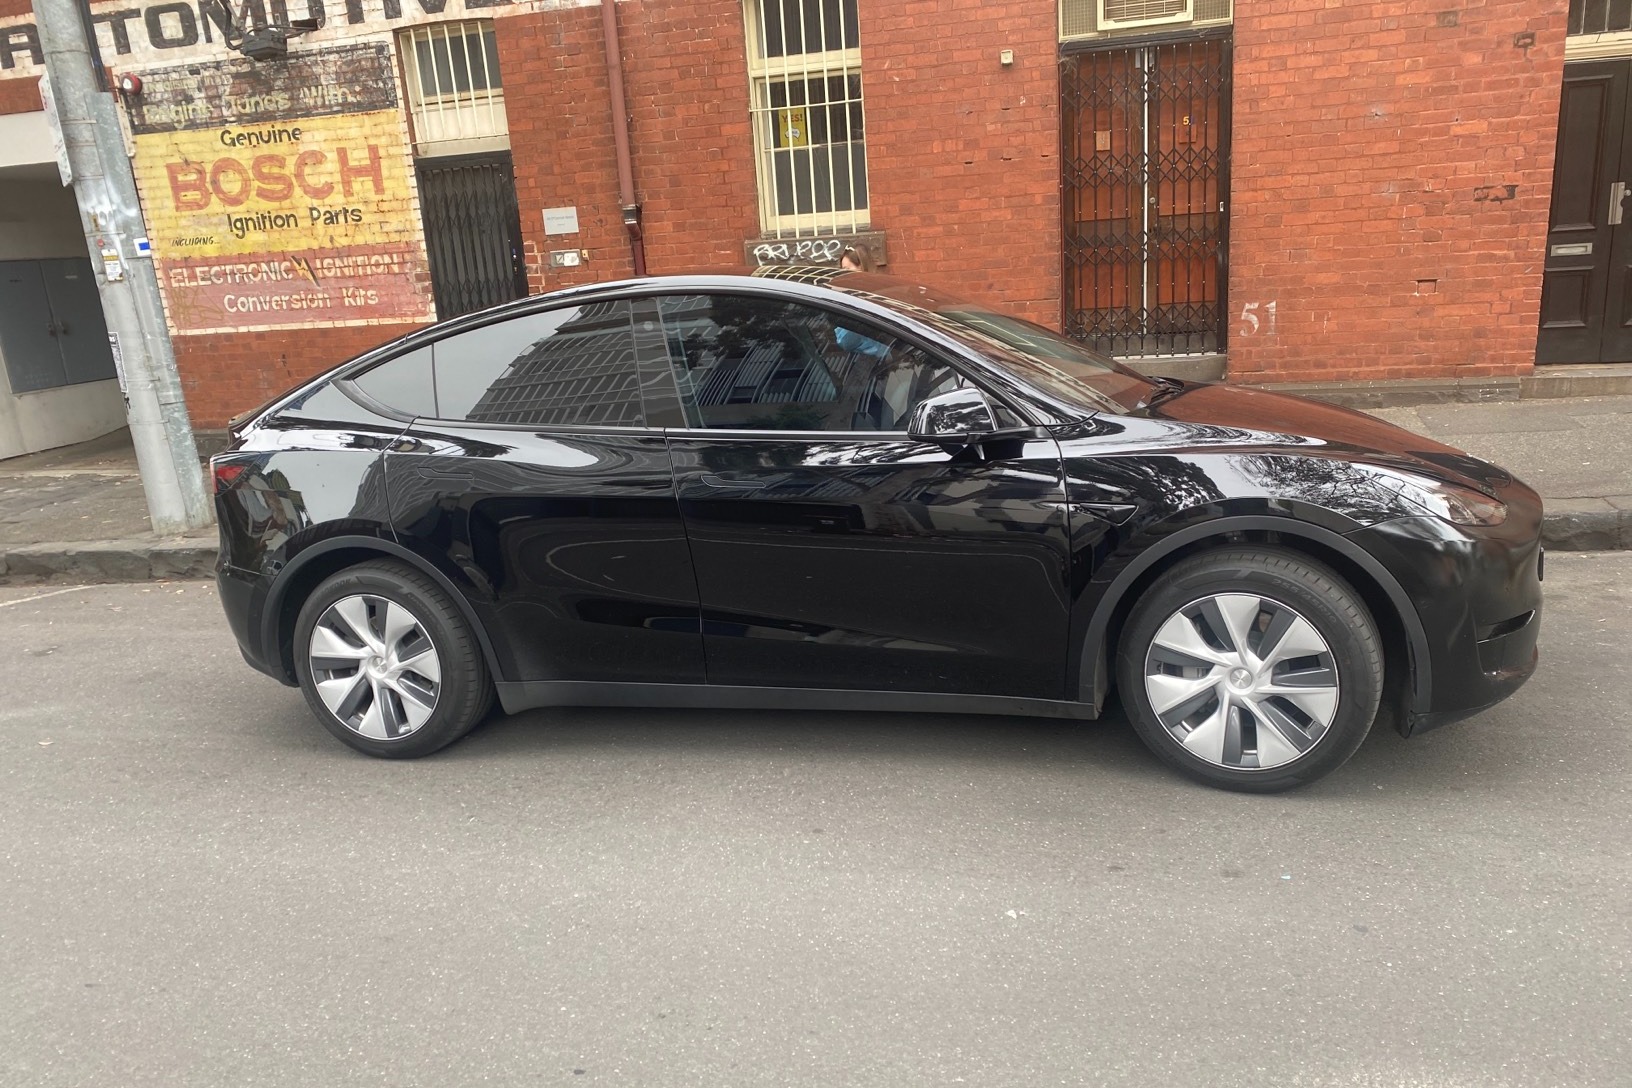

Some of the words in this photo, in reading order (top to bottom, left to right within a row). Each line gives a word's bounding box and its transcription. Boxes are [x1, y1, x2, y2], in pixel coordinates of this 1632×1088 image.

[782, 113, 803, 123] YES!
[220, 124, 301, 147] Genuine
[166, 144, 386, 212] BOSCH
[226, 210, 299, 239] Ignition
[309, 206, 363, 226] Parts
[169, 261, 293, 288] ELECTRONIC
[315, 253, 400, 278] IGNITION
[223, 291, 332, 313] Conversion
[342, 287, 379, 307] Kits
[1240, 301, 1277, 337] 51
